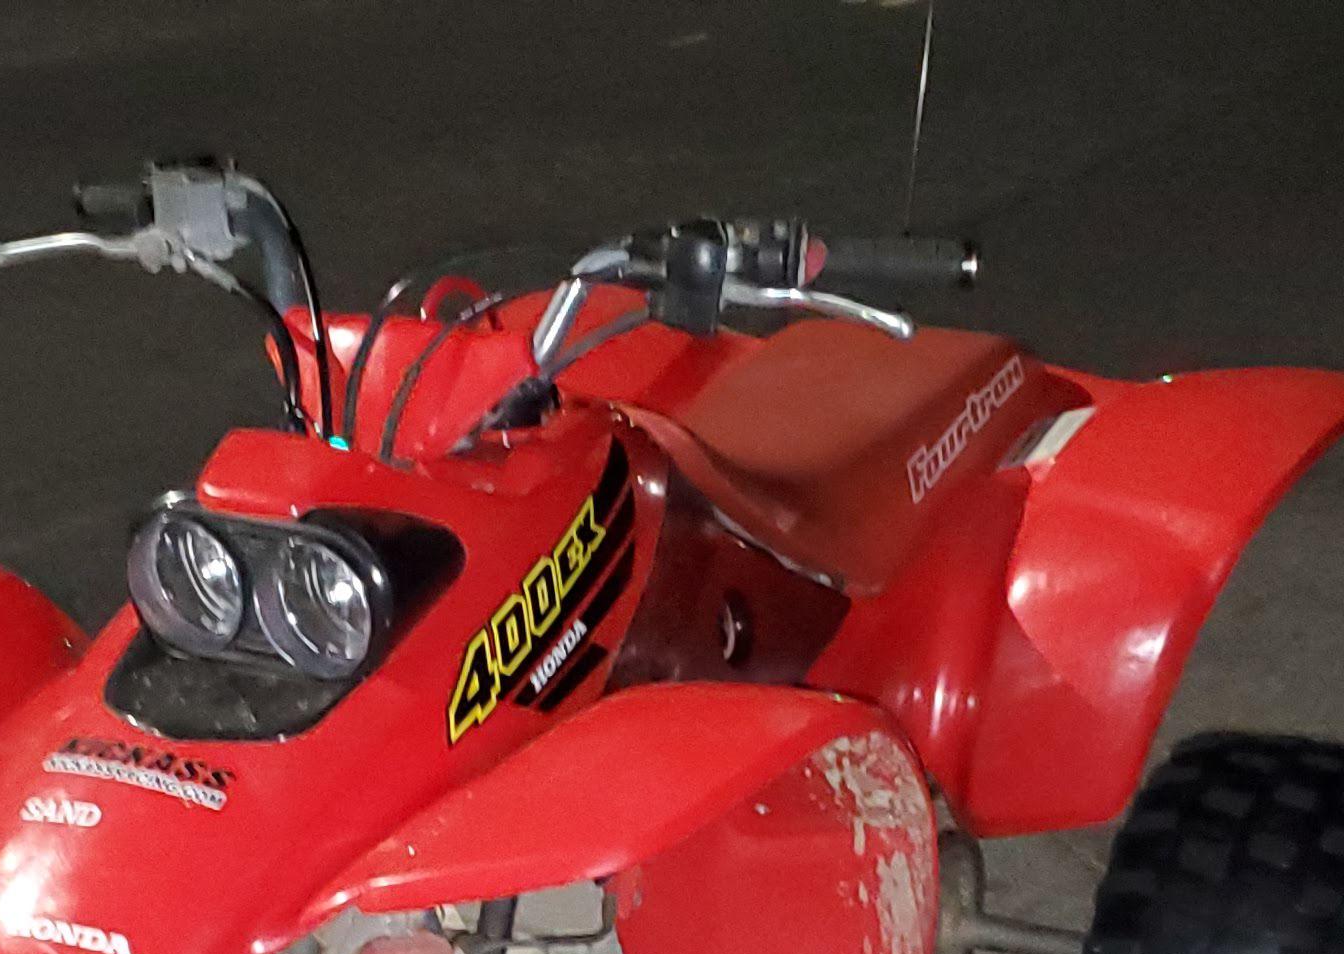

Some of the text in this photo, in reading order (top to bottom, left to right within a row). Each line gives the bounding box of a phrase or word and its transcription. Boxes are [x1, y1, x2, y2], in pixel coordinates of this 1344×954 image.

[448, 496, 606, 745] 400EX
[529, 618, 588, 694] HONDA
[20, 796, 103, 828] SAND
